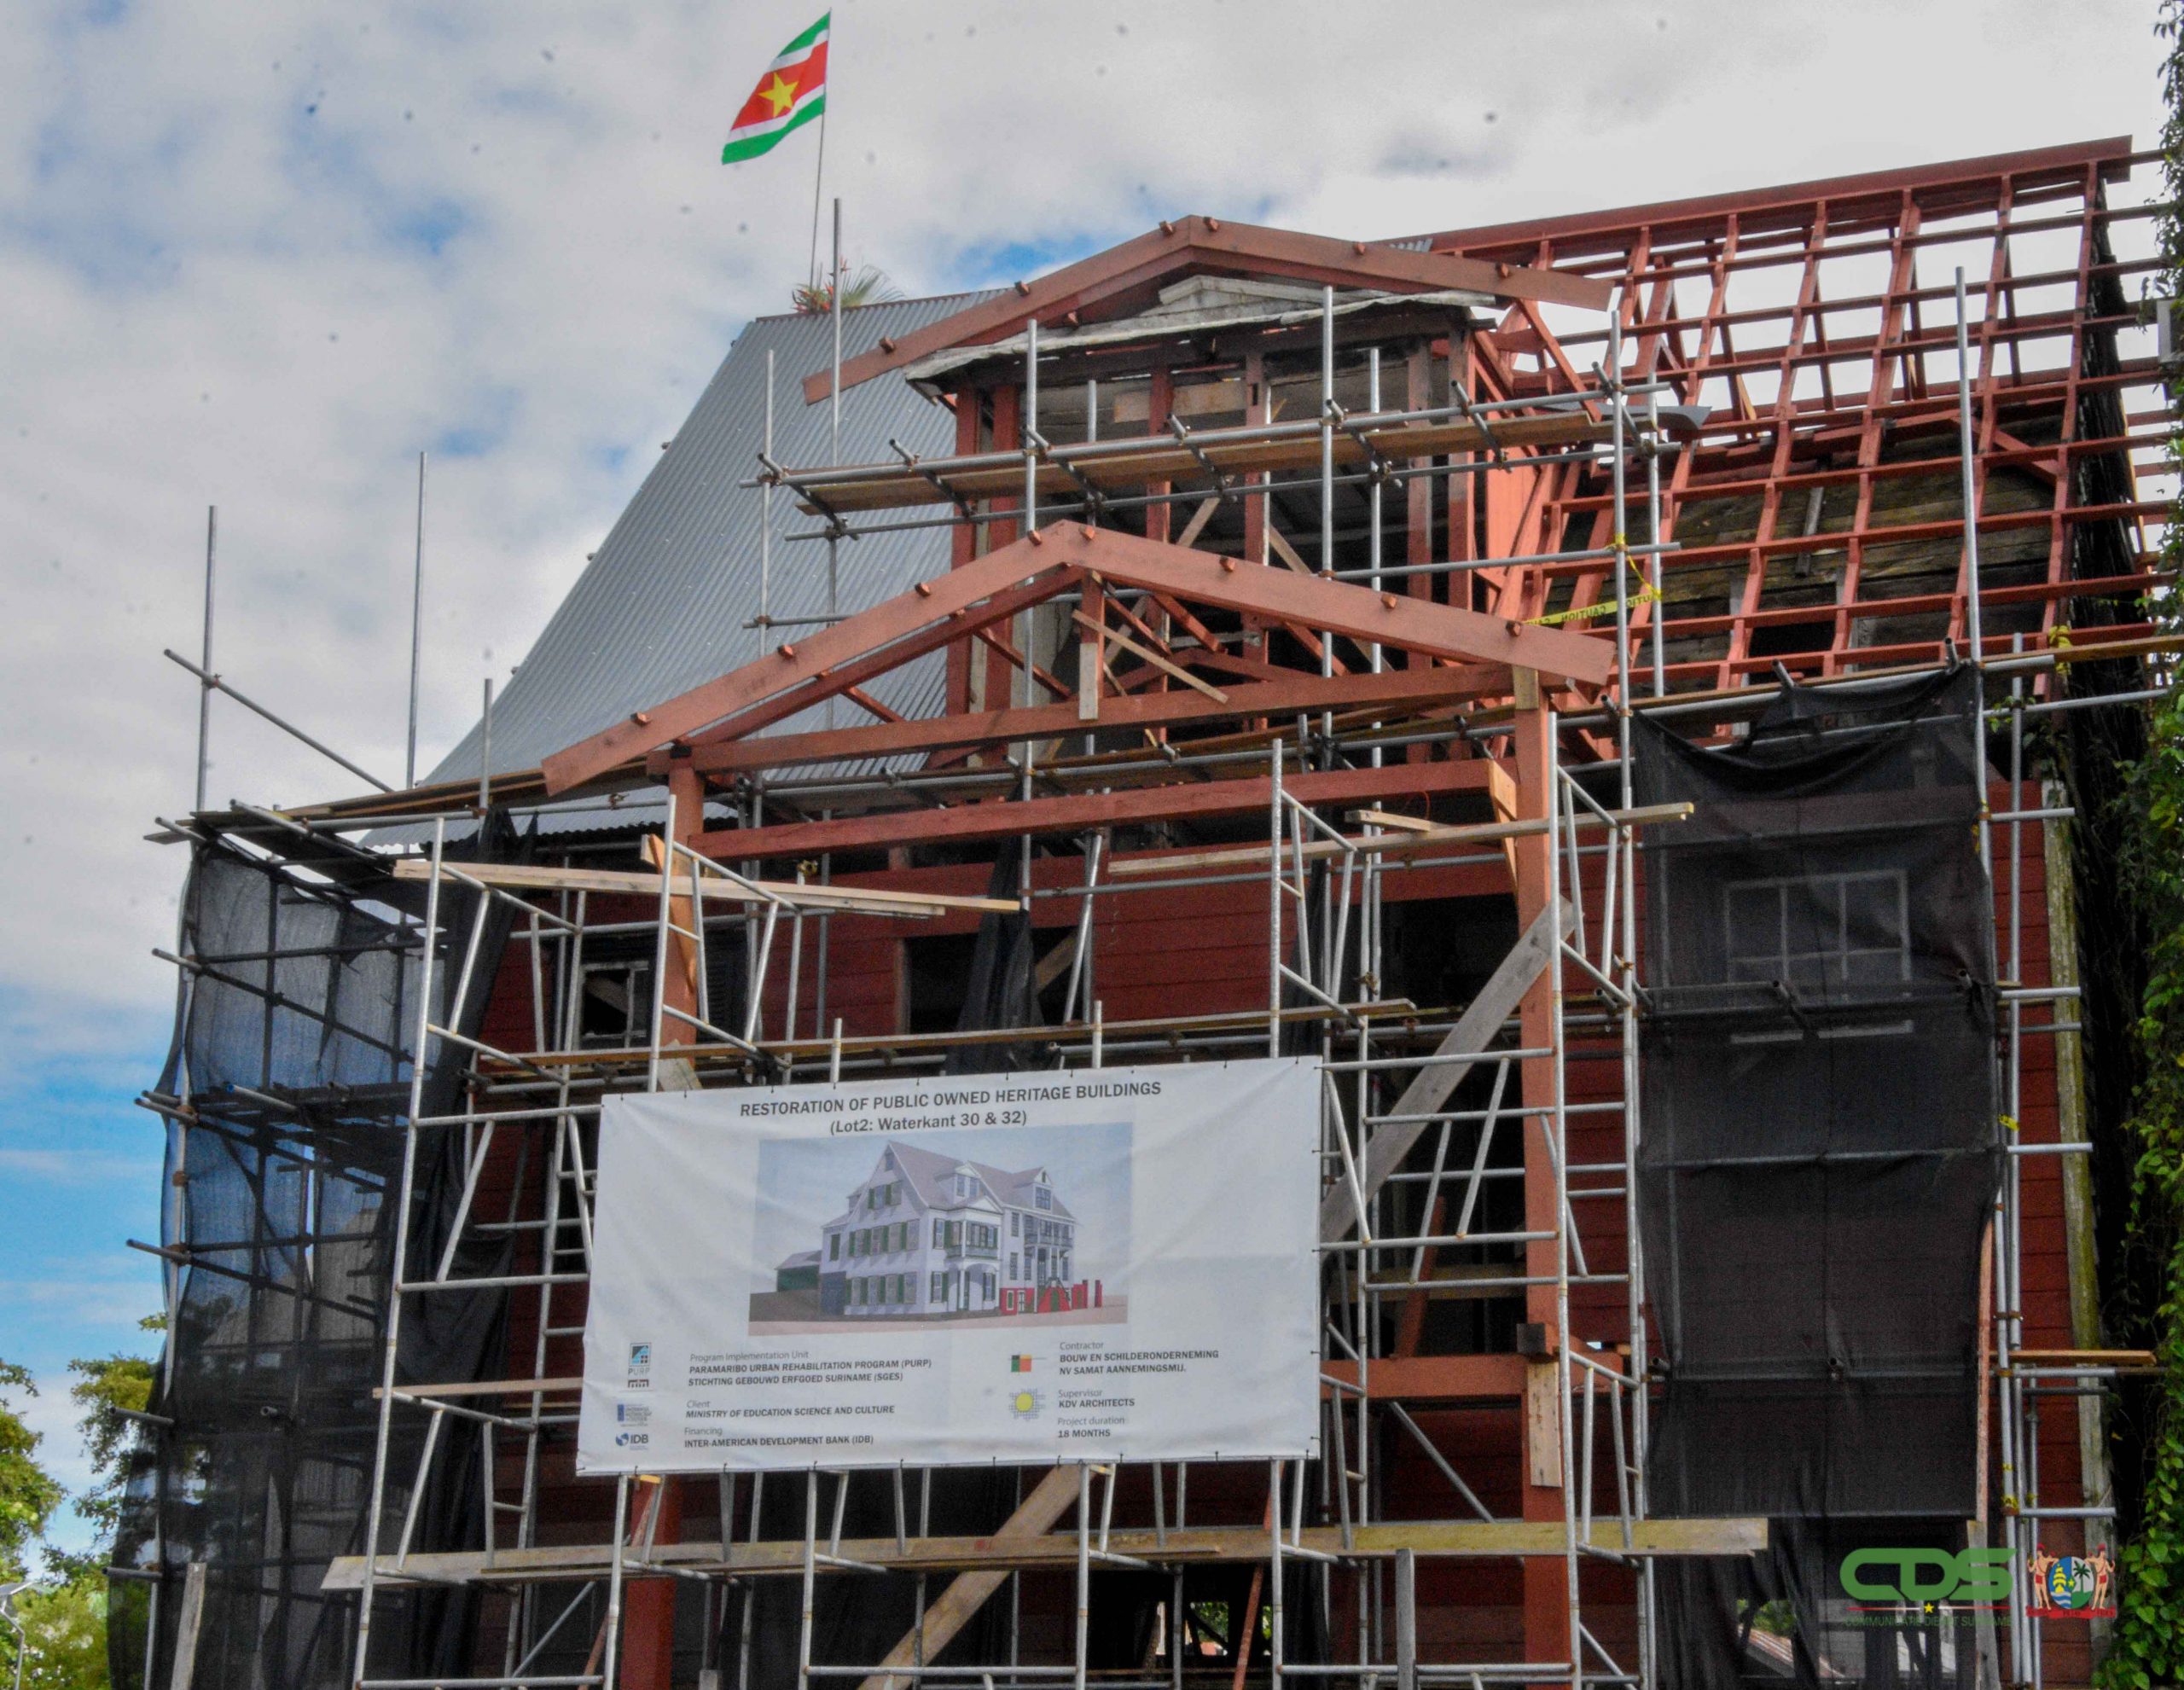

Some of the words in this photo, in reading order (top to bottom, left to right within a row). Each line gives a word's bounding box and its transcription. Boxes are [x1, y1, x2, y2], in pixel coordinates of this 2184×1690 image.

[741, 1099, 844, 1117] RESTORATION
[849, 1098, 868, 1112] OF
[874, 1094, 929, 1110] PUBLIC
[933, 1090, 990, 1106] OWNED
[996, 1086, 1072, 1102] HERITAGE
[1076, 1082, 1162, 1099] BUILDINGS
[830, 1118, 873, 1135] (Lot2:
[878, 1114, 956, 1131] Waterkant
[960, 1112, 980, 1126] 30
[985, 1112, 997, 1125] &
[1001, 1110, 1027, 1126] 32)
[1060, 1341, 1104, 1350] Contractor
[689, 1353, 724, 1363] Program
[725, 1350, 790, 1362] Implementation
[792, 1350, 810, 1359] Unit
[1060, 1353, 1089, 1363] BOUW
[1090, 1353, 1101, 1362] EN
[1104, 1350, 1219, 1362] SCHILDERONDERNEMING
[689, 1364, 748, 1374] PARAMARIBO
[749, 1363, 780, 1373] URBAN
[781, 1361, 852, 1371] REHABILITATION
[854, 1360, 899, 1370] PROGRAM
[901, 1359, 932, 1368] (PURP)
[1060, 1367, 1072, 1375] NV
[1073, 1366, 1104, 1375] SAMAT
[1107, 1364, 1187, 1374] AANNEMINGSMIJ.
[688, 1377, 733, 1386] STICHTING
[735, 1376, 780, 1385] GEBOUWD
[781, 1374, 823, 1384] ERFGOED
[825, 1373, 873, 1382] SURINAME
[874, 1372, 903, 1382] (SGES)
[1058, 1389, 1103, 1399] Supervisor
[686, 1400, 711, 1408] Client
[1059, 1399, 1077, 1408] KDV
[1079, 1398, 1136, 1408] ARCHITECTS
[686, 1409, 728, 1418] MINISTRY
[743, 1408, 793, 1417] EDUCATION
[794, 1407, 833, 1416] SCIENCE
[834, 1406, 853, 1414] AND
[855, 1405, 896, 1414] CULTURE
[1058, 1416, 1088, 1426] Project
[1089, 1415, 1125, 1426] duration
[684, 1426, 723, 1437] Financing
[1058, 1430, 1070, 1438] 18
[1072, 1429, 1111, 1438] MONTHS
[630, 1434, 649, 1444] IDB
[684, 1437, 758, 1448] INTER-AMERICAN
[759, 1437, 823, 1446] DEVELOPMENT
[826, 1436, 851, 1444] BANK
[852, 1435, 874, 1445] (IDB)
